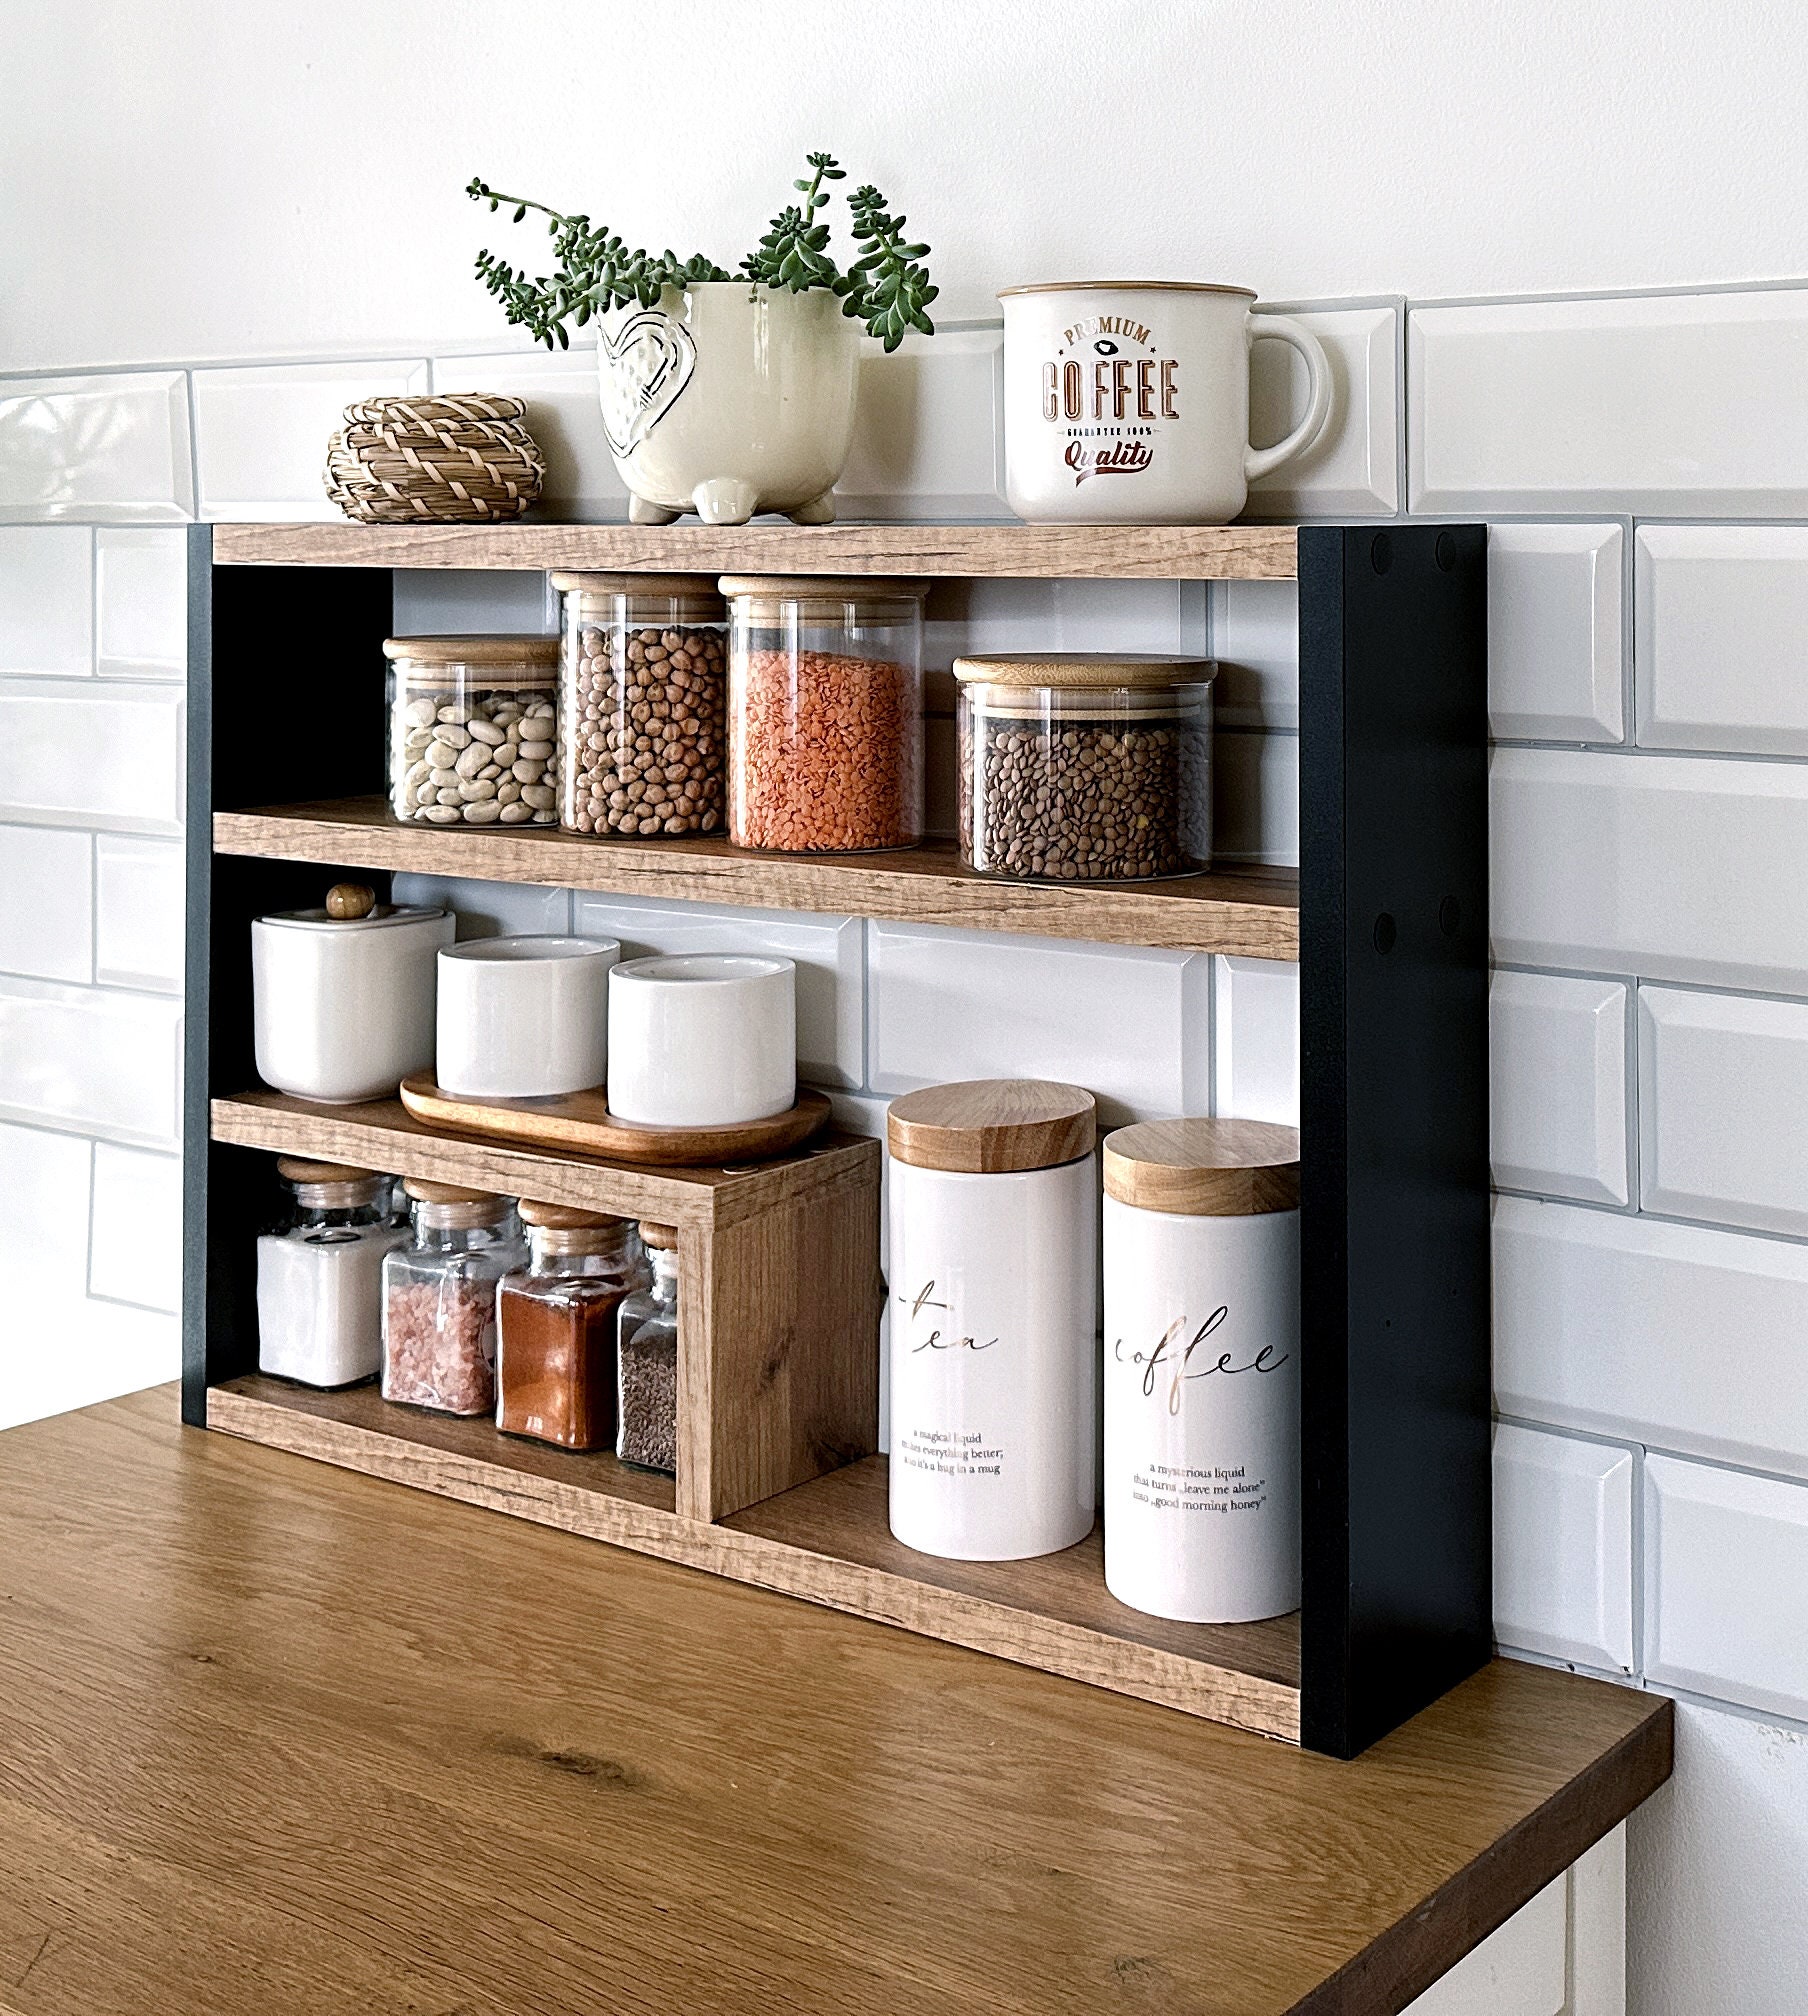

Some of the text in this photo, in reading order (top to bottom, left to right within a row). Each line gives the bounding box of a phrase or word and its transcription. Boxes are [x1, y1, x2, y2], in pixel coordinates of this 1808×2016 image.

[1063, 316, 1152, 346] PREMIUM
[1042, 359, 1180, 422] COFFEE
[1065, 440, 1154, 487] Quality
[898, 1280, 999, 1353] tea
[1115, 1305, 1289, 1416] coffee
[953, 1431, 982, 1446] lquid
[969, 1466, 975, 1474] a
[977, 1465, 1000, 1475] mug
[1149, 1464, 1155, 1473] a
[1214, 1466, 1245, 1481] liquid
[1151, 1479, 1177, 1491] turns
[1213, 1485, 1229, 1494] me
[1182, 1499, 1228, 1513] morning
